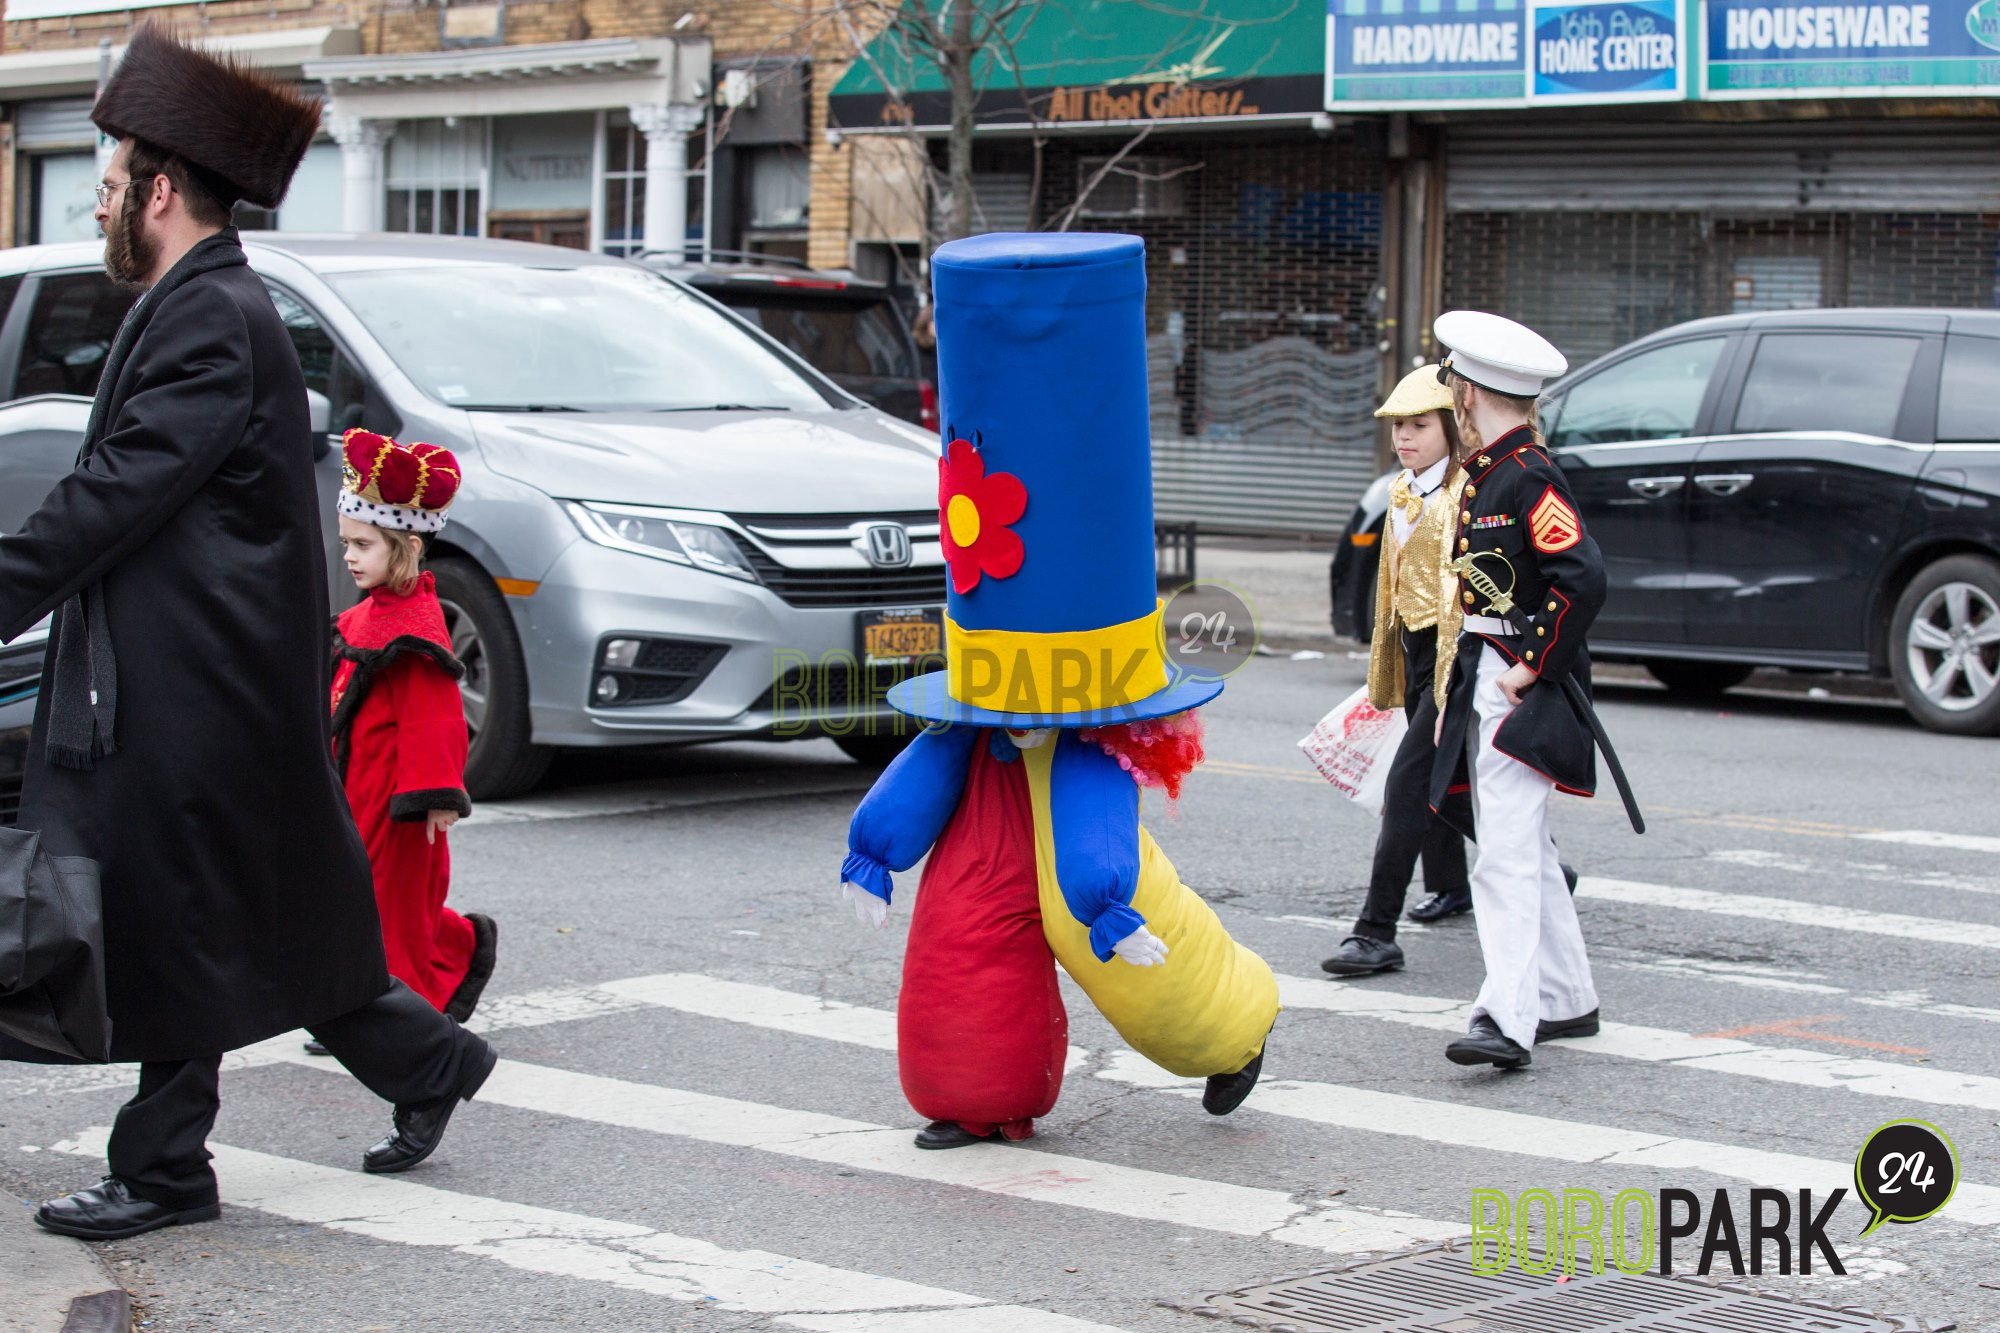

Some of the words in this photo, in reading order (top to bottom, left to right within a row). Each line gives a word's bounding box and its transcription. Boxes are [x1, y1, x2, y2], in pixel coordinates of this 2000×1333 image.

[1352, 22, 1518, 65] HARDWARE
[1560, 11, 1604, 40] 16th
[1726, 5, 1930, 50] HOUSEWARE
[1539, 36, 1599, 74] HOME
[1602, 33, 1675, 71] CENTER
[1049, 86, 1085, 121] All
[1089, 85, 1140, 120] that
